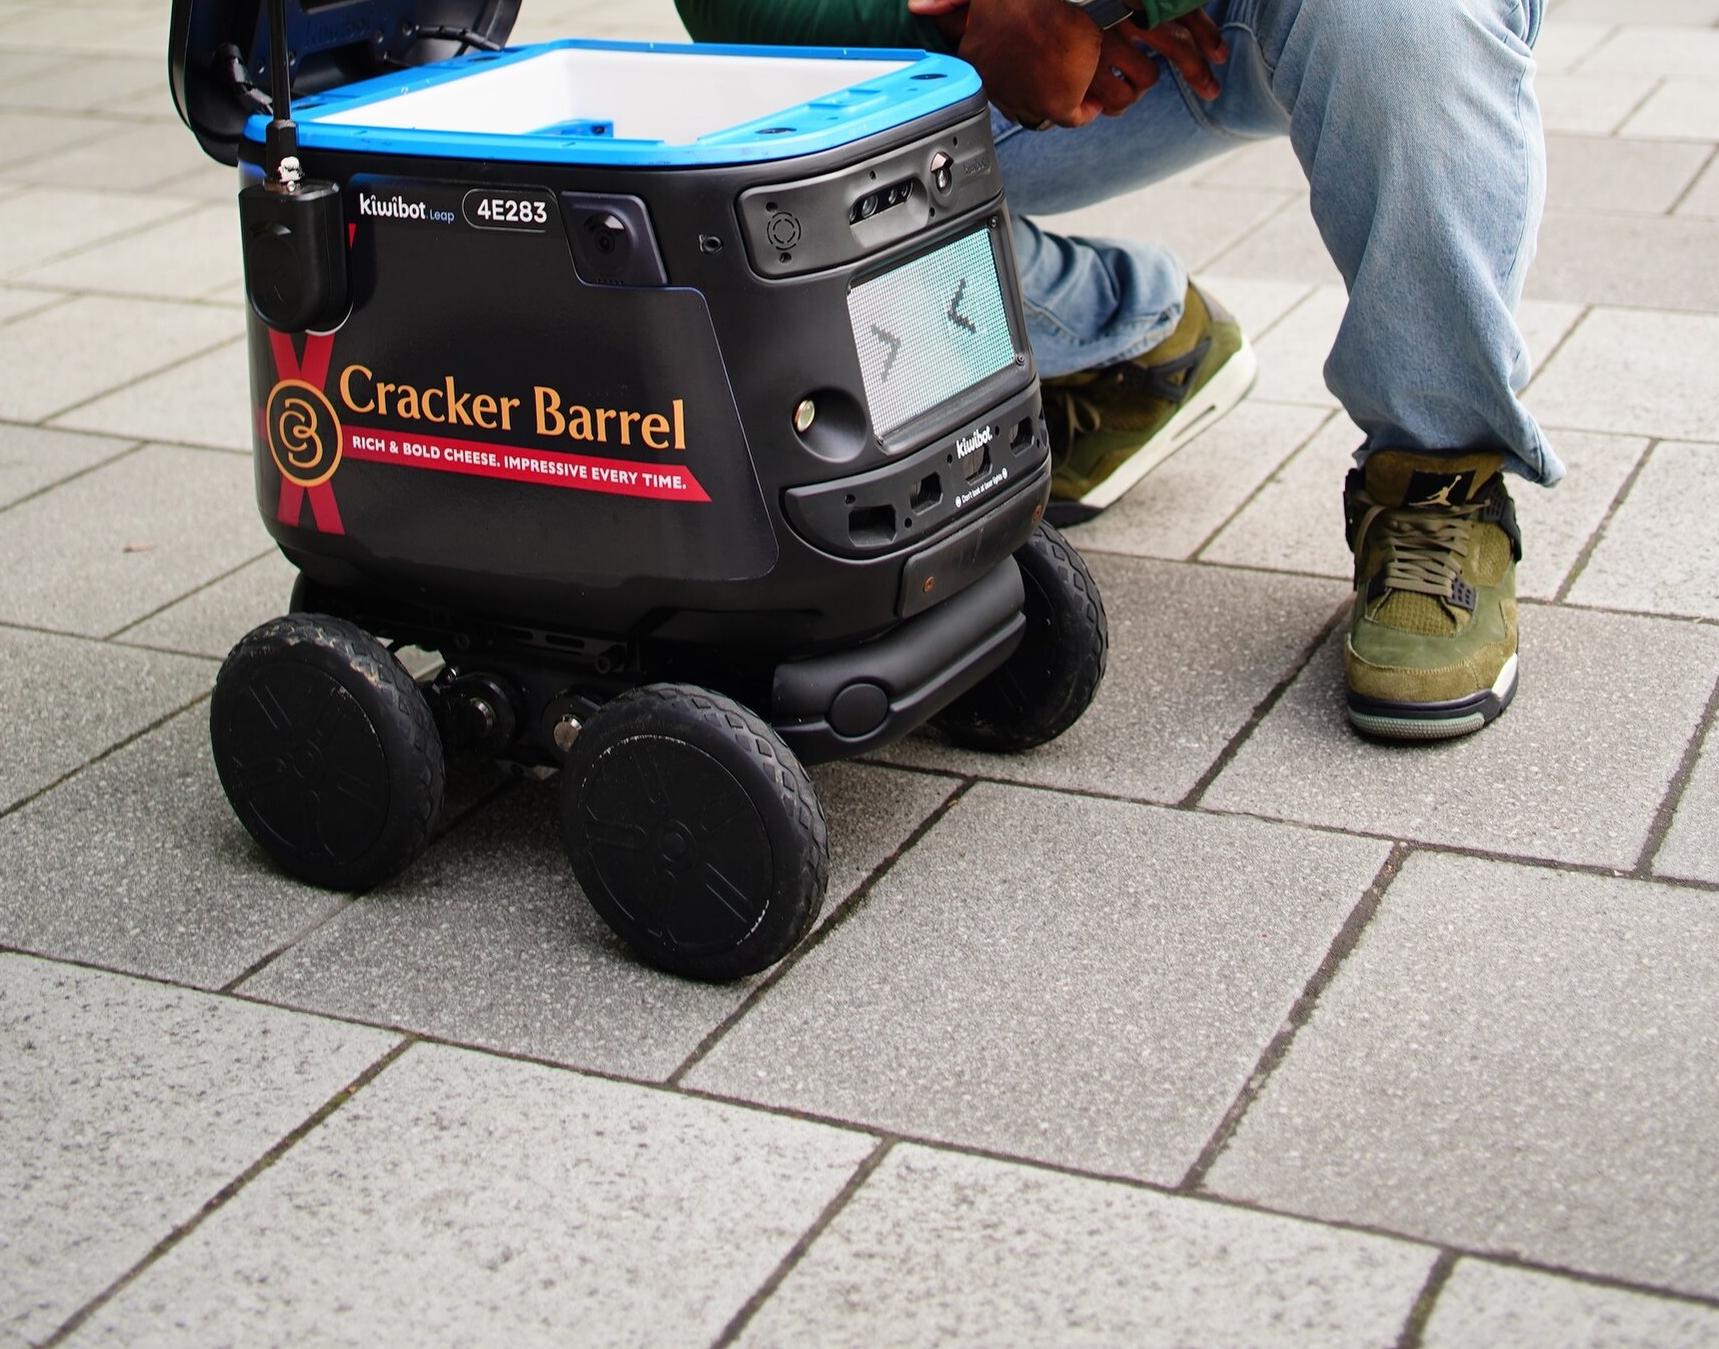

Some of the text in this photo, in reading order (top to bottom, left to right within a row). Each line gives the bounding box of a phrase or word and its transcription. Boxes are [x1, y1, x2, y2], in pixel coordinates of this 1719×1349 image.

[477, 199, 548, 224] 4E283
[340, 364, 686, 449] Cracker Barrel
[352, 435, 687, 490] RICH & BOLD CHEESE. IMPRESSIVE EVERY TIME.
